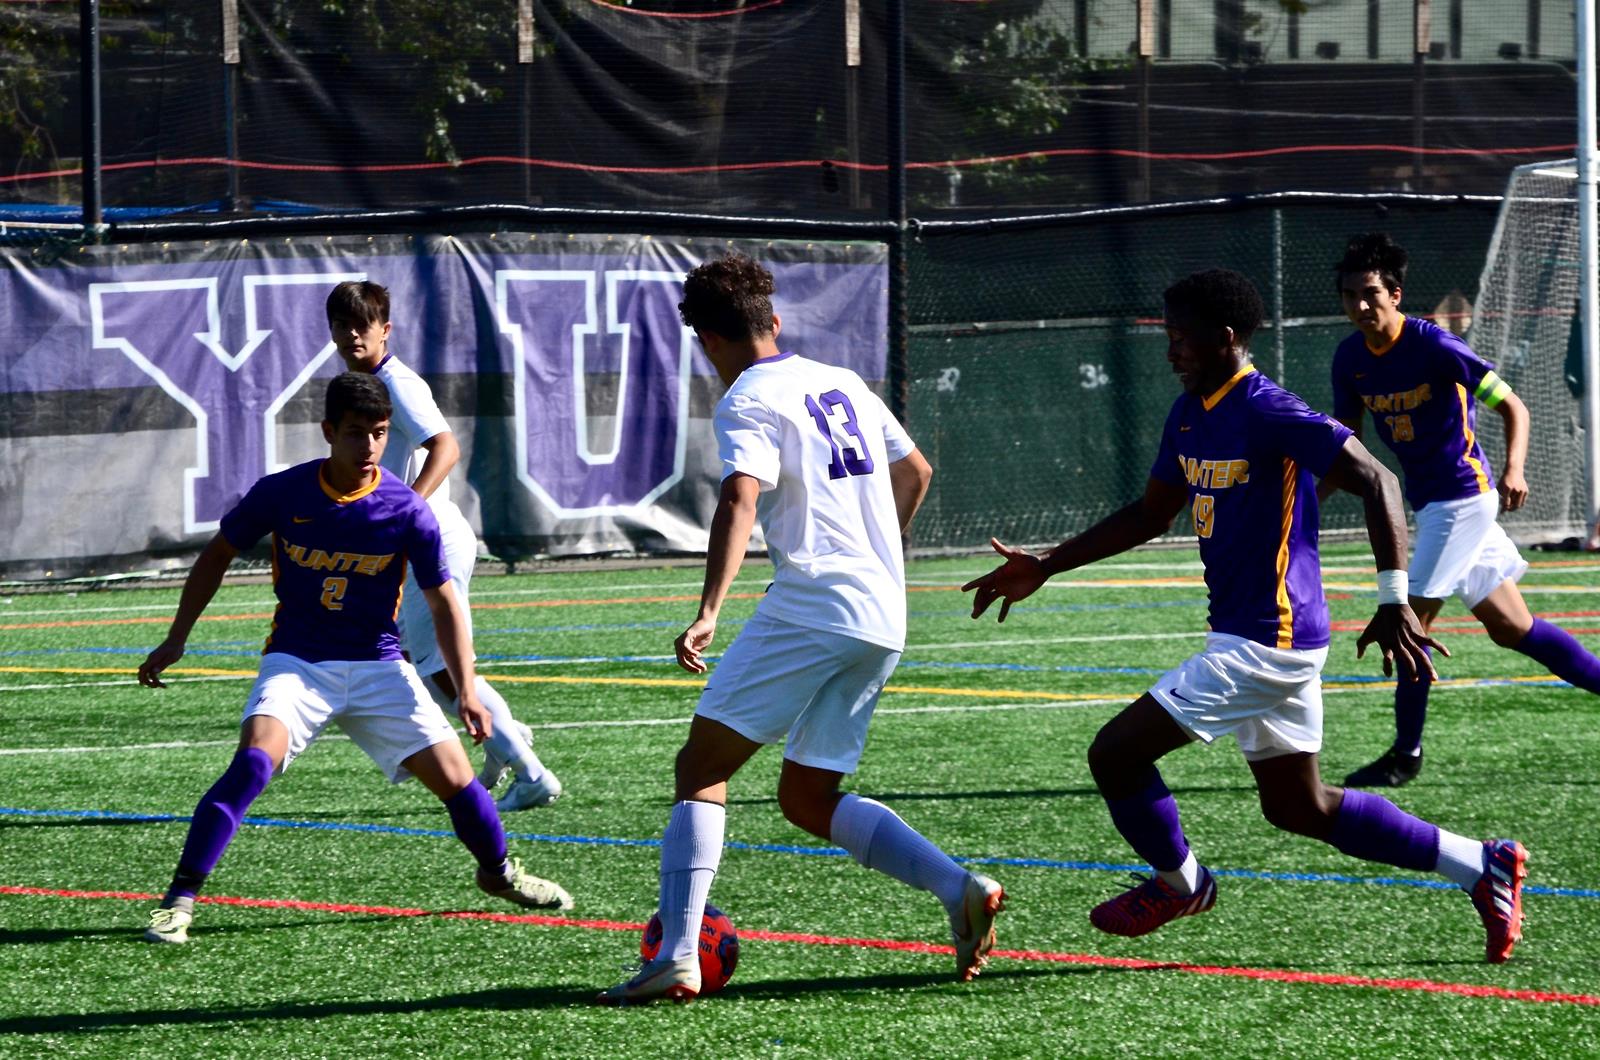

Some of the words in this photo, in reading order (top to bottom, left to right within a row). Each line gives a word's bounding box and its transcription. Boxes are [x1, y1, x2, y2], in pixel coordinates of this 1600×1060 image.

[804, 389, 874, 480] 13
[1178, 454, 1249, 488] UNTER
[1192, 493, 1215, 538] 19
[320, 577, 348, 611] 2
